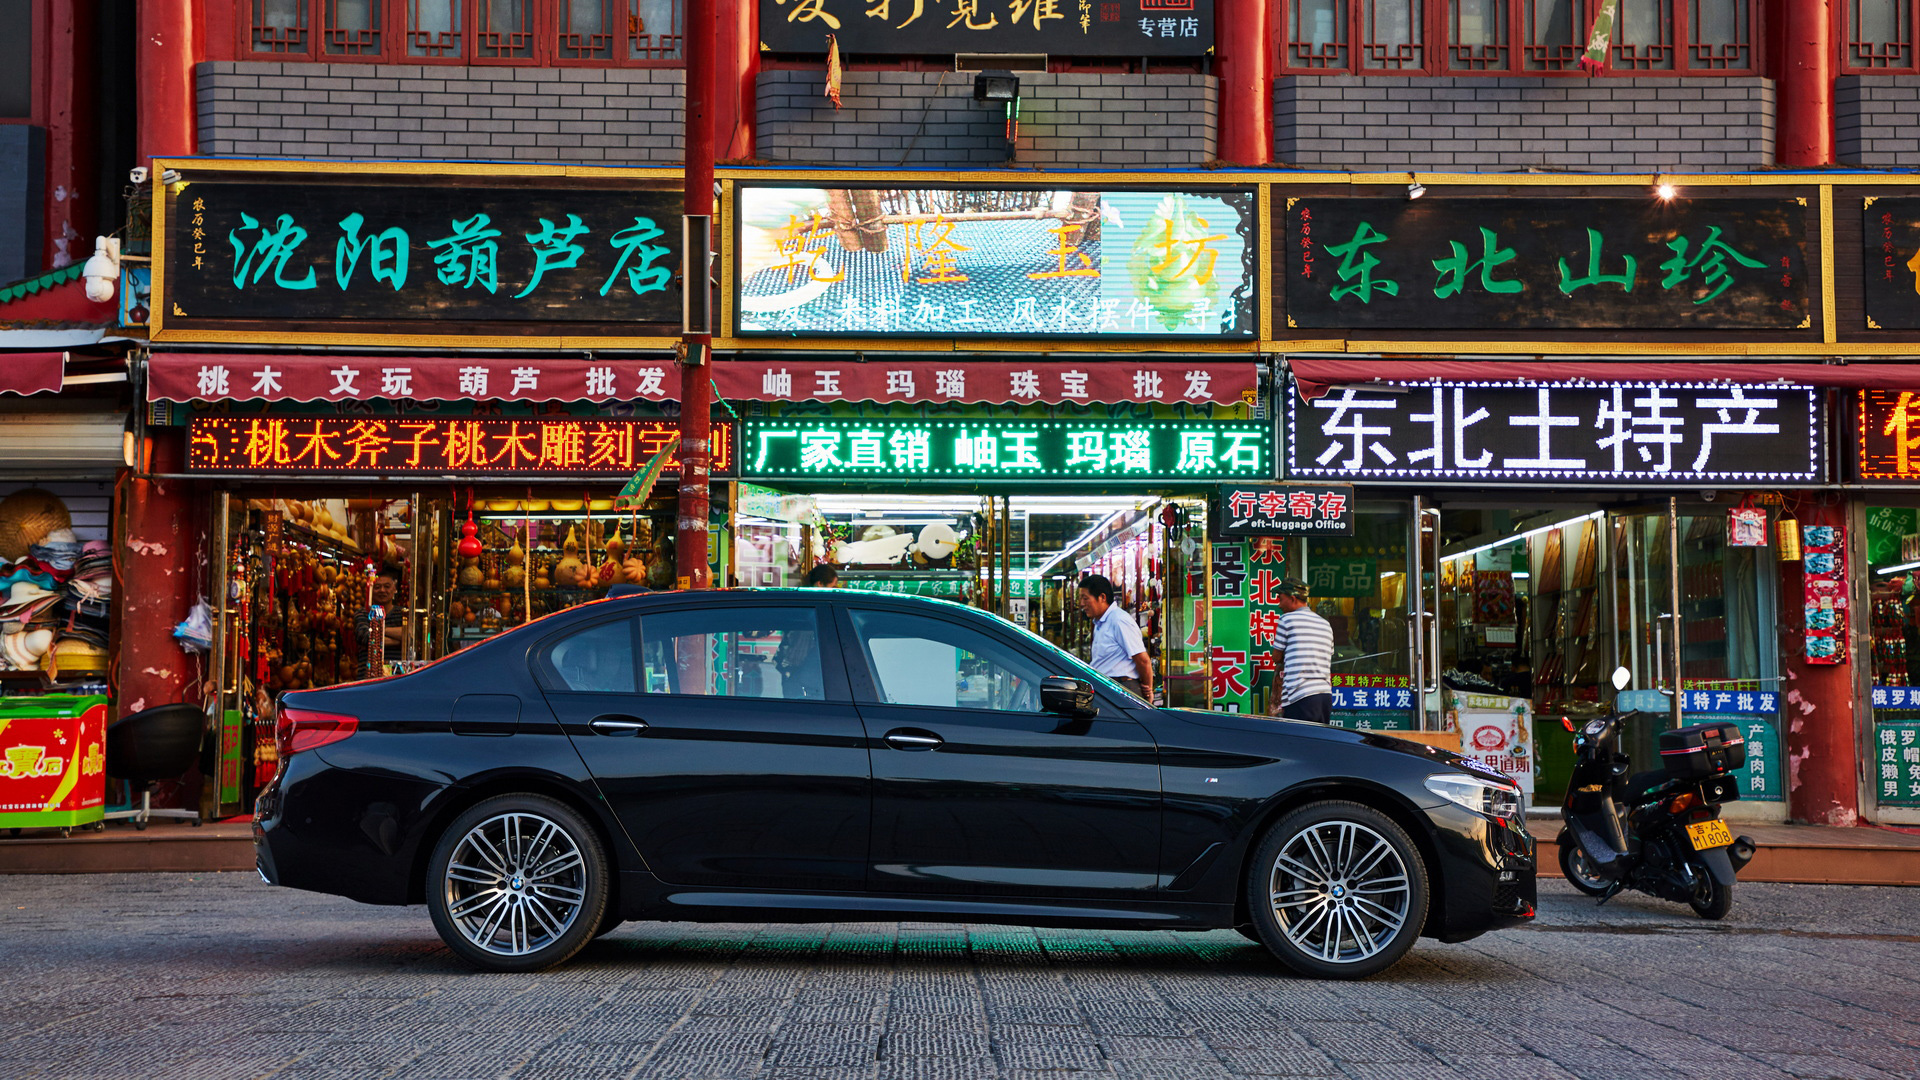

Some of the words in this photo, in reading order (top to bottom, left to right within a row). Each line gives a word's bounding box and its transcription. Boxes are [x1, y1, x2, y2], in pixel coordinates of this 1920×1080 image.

[1138, 16, 1199, 38] 专营店
[229, 211, 674, 299] 沈阳葫芦店
[770, 214, 1228, 286] 乾隆玉坊
[1323, 221, 1771, 304] 东北山珍
[836, 294, 985, 328] 来料加工
[1012, 296, 1161, 331] 风水摆件
[197, 366, 282, 396] 桃木
[330, 366, 413, 396] 文玩
[458, 366, 540, 396] 葫芦
[586, 366, 667, 397] 批发
[762, 369, 842, 397] 岫玉
[887, 369, 966, 398] 玛瑙
[1010, 370, 1090, 399] 珠宝
[1133, 370, 1213, 399] 批发
[1312, 387, 1781, 474] 东北土特产
[754, 429, 931, 471] 厂家直销
[954, 429, 1041, 471] 岫玉
[1066, 430, 1152, 472] 玛瑙
[1176, 431, 1264, 472] 原石
[1229, 489, 1348, 519] 行李寄存
[1315, 518, 1347, 529] Office
[1307, 562, 1372, 590] 商品
[1332, 689, 1412, 708] 九宝批发
[1468, 754, 1530, 774] 里道斯
[1693, 830, 1731, 850] M1808
